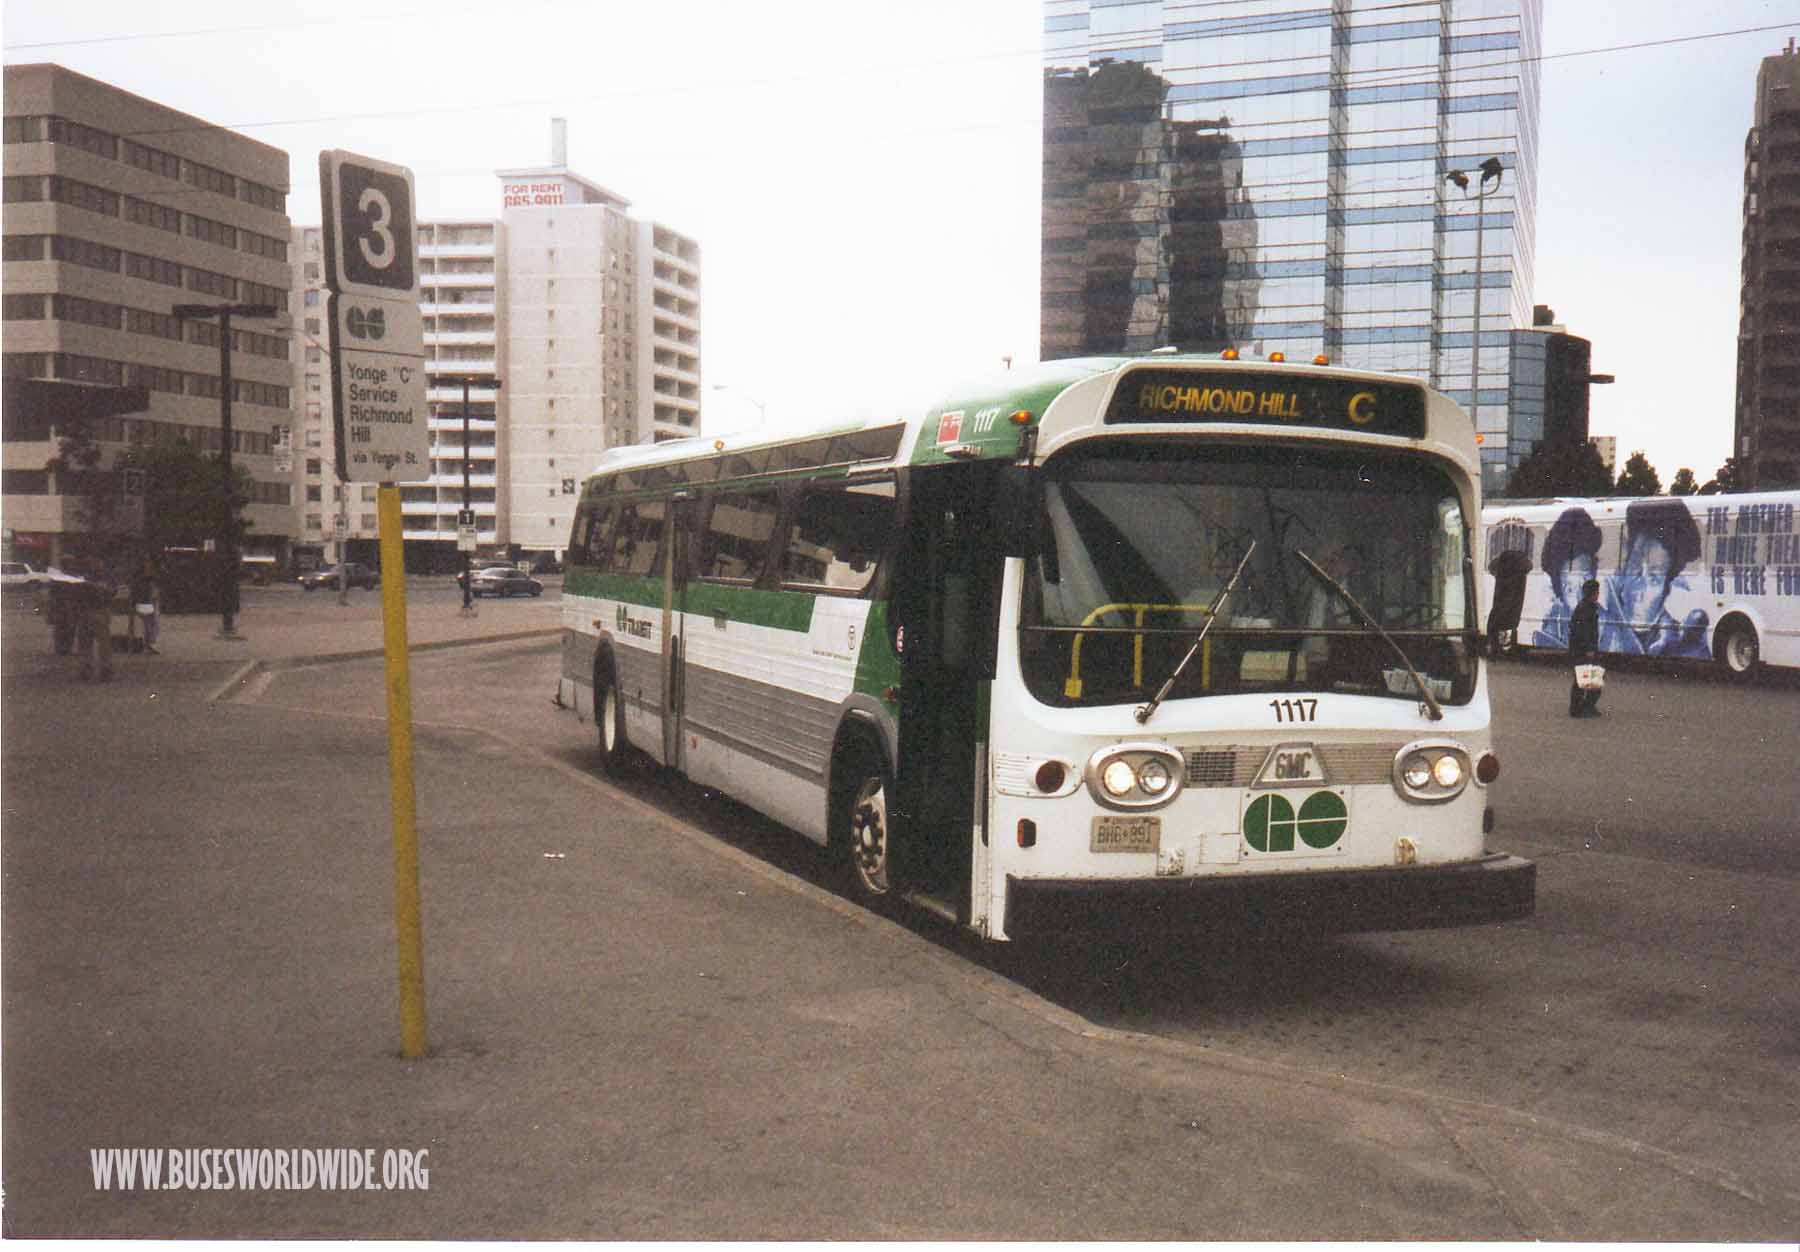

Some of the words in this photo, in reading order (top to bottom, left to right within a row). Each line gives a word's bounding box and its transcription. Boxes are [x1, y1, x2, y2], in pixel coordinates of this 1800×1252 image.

[504, 184, 529, 194] FOR
[531, 183, 561, 193] RENT
[358, 187, 396, 270] 3
[348, 362, 387, 385] Yonge
[350, 384, 398, 403] Service
[1139, 384, 1255, 415] RICHMOND
[1259, 391, 1300, 417] HILL
[1348, 391, 1376, 423] C
[350, 404, 414, 424] Richmond
[973, 407, 1001, 433] 1117
[351, 425, 371, 443] Hill
[353, 452, 367, 464] via
[371, 450, 401, 466] Yonge
[405, 450, 418, 465] St.
[1269, 698, 1318, 722] 1117
[1275, 751, 1312, 779] GMC
